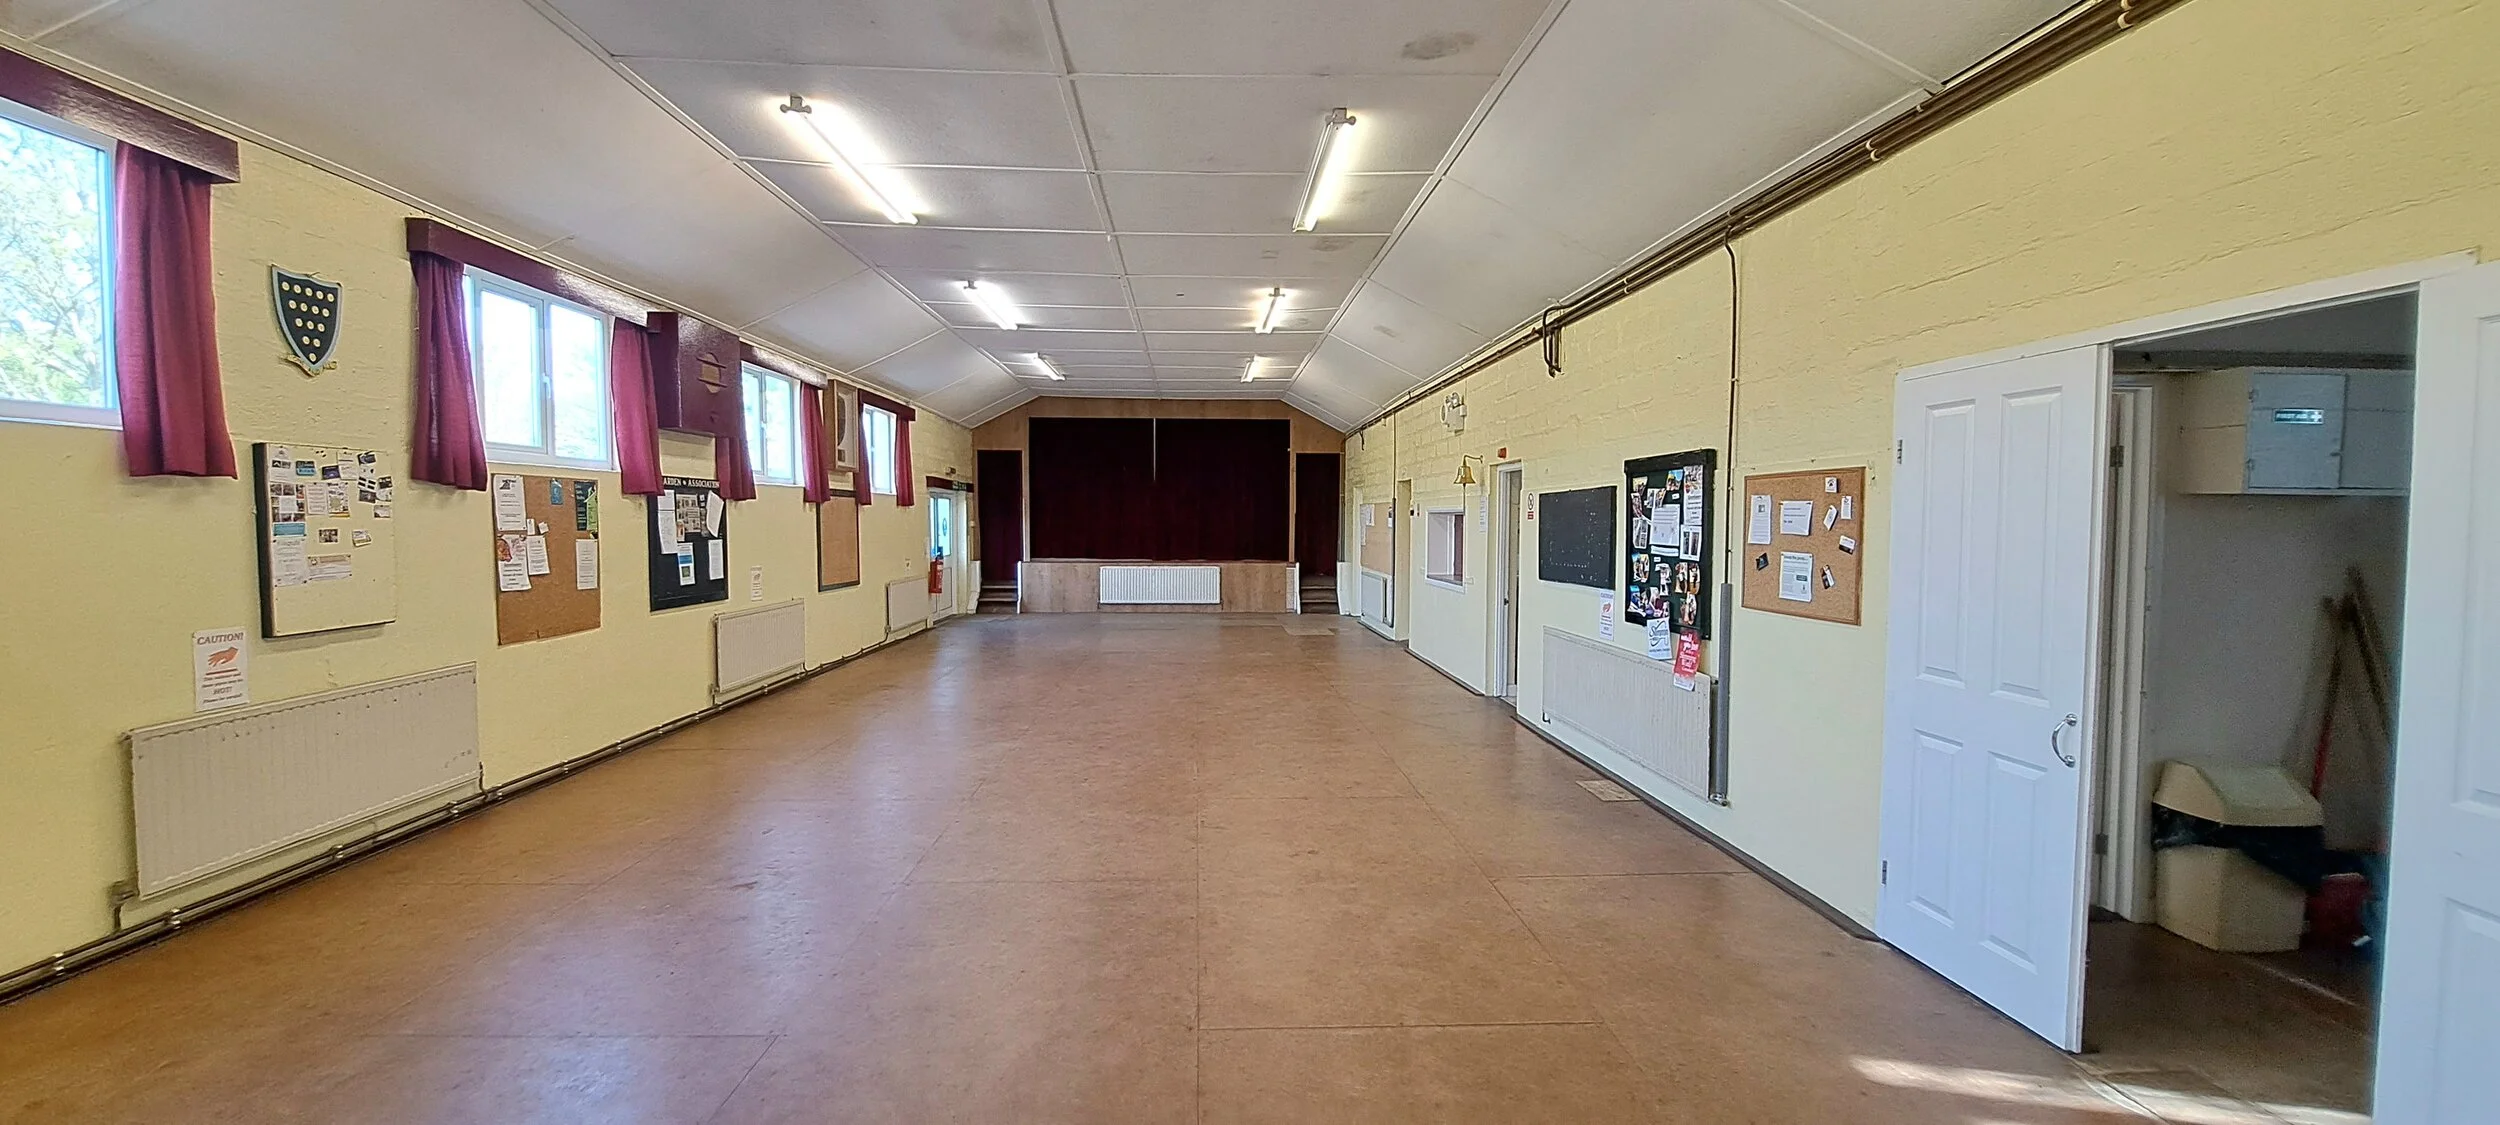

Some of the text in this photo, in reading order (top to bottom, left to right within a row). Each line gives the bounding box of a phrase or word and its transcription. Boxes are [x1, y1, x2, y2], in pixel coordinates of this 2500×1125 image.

[663, 477, 681, 486] ARDEN
[197, 632, 244, 646] CAUTION!
[213, 687, 232, 695] HOT!
